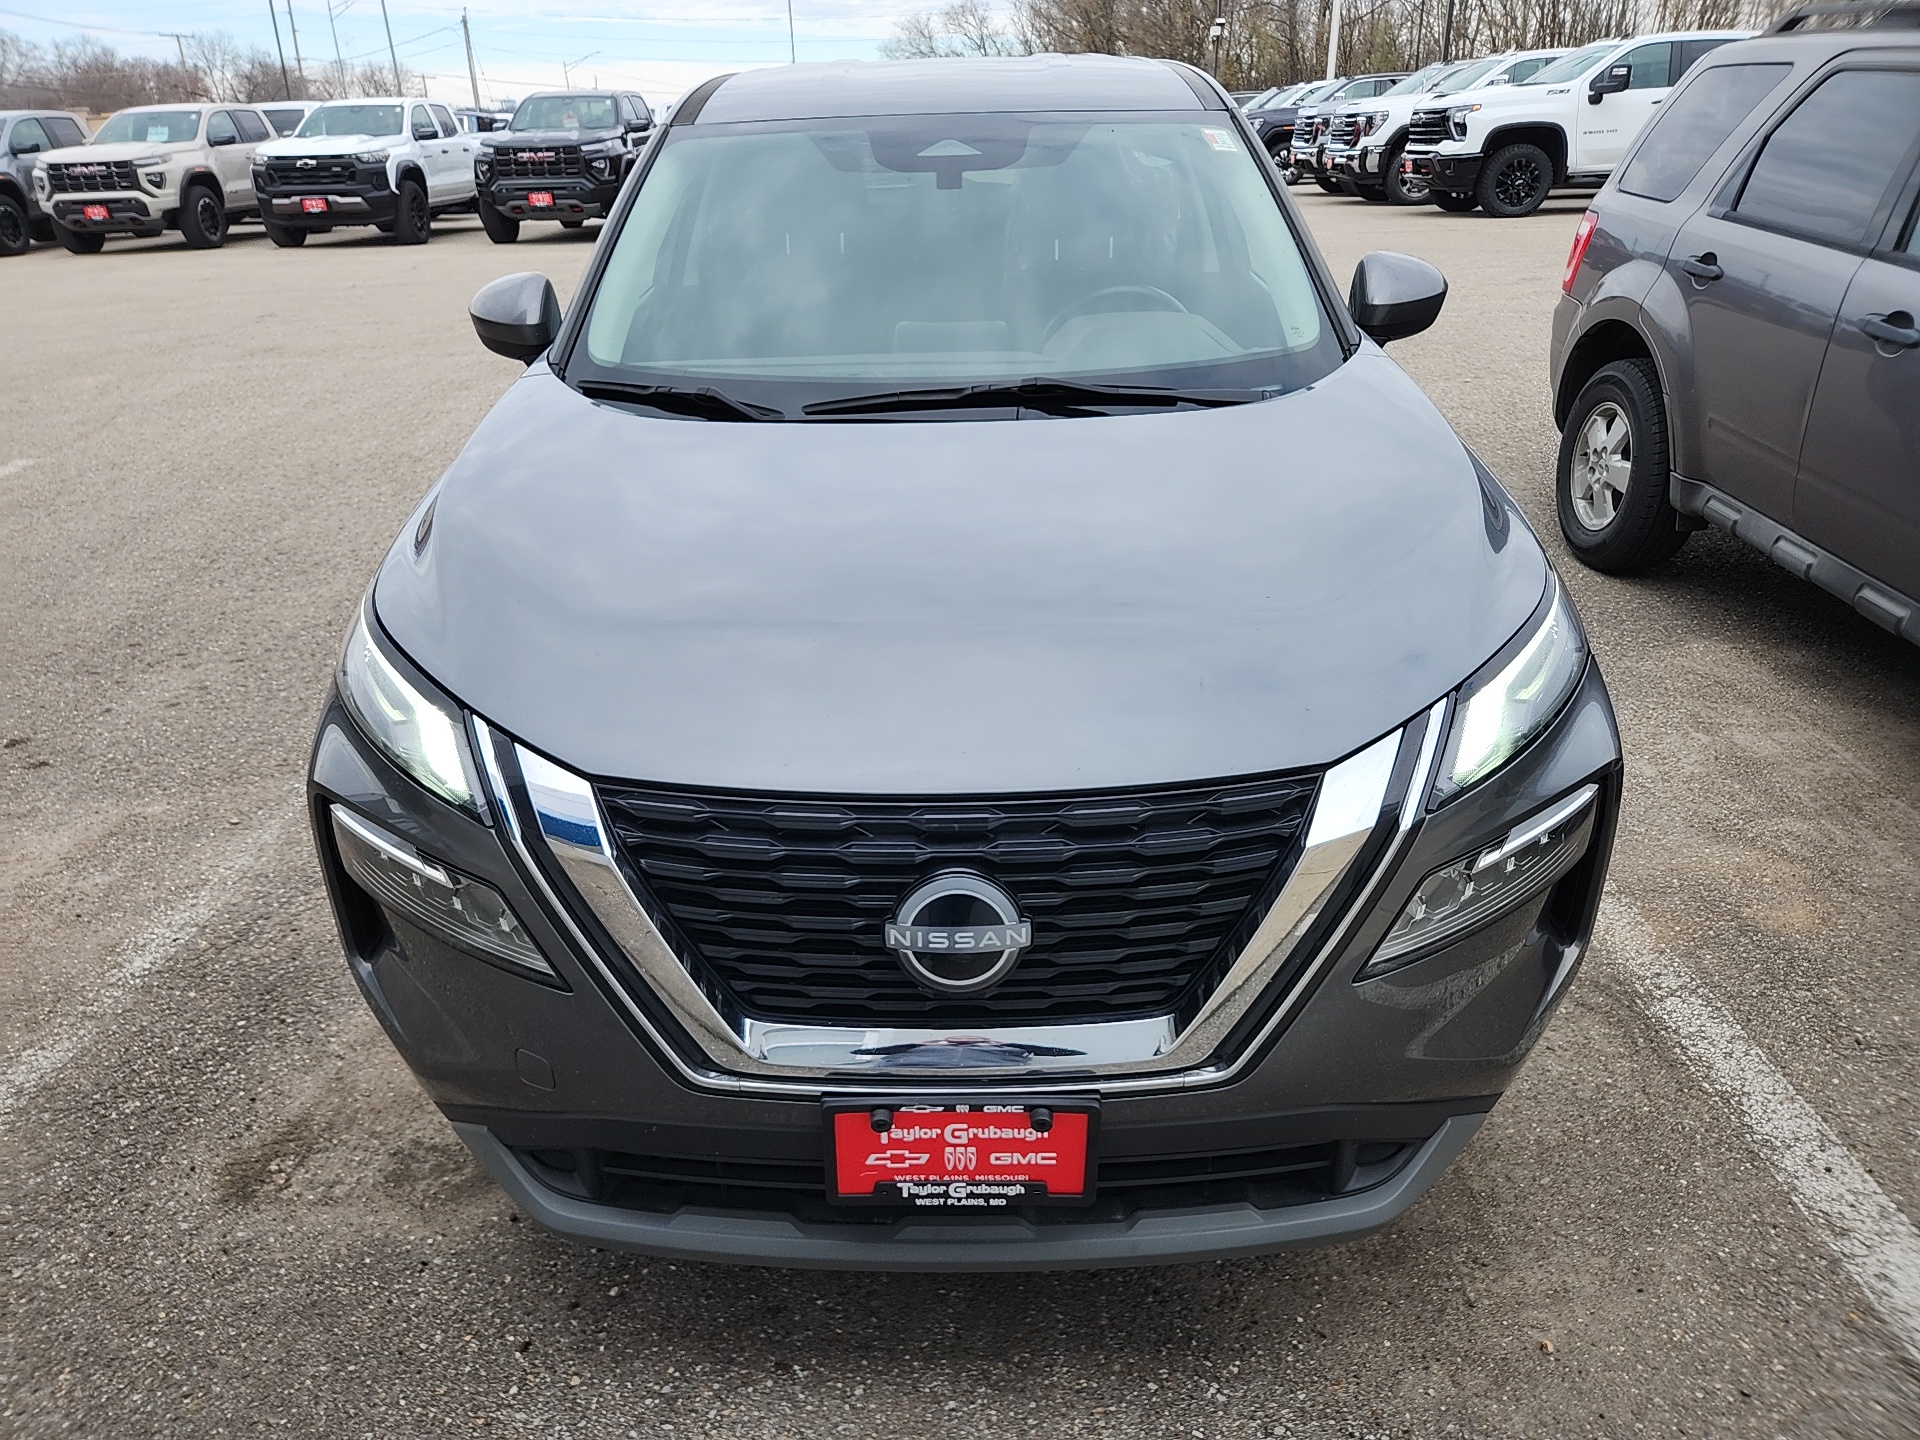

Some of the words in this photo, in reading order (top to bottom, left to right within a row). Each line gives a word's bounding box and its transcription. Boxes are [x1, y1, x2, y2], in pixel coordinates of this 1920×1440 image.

[889, 928, 1027, 949] NISSAN
[983, 1105, 1025, 1113] GMC
[989, 1152, 1057, 1165] GMC
[896, 1182, 947, 1198] Taylor
[948, 1182, 1025, 1198] Grubaugh
[915, 1198, 945, 1206] WEST
[946, 1198, 988, 1207] PLAINS,
[989, 1198, 1007, 1206] MO
